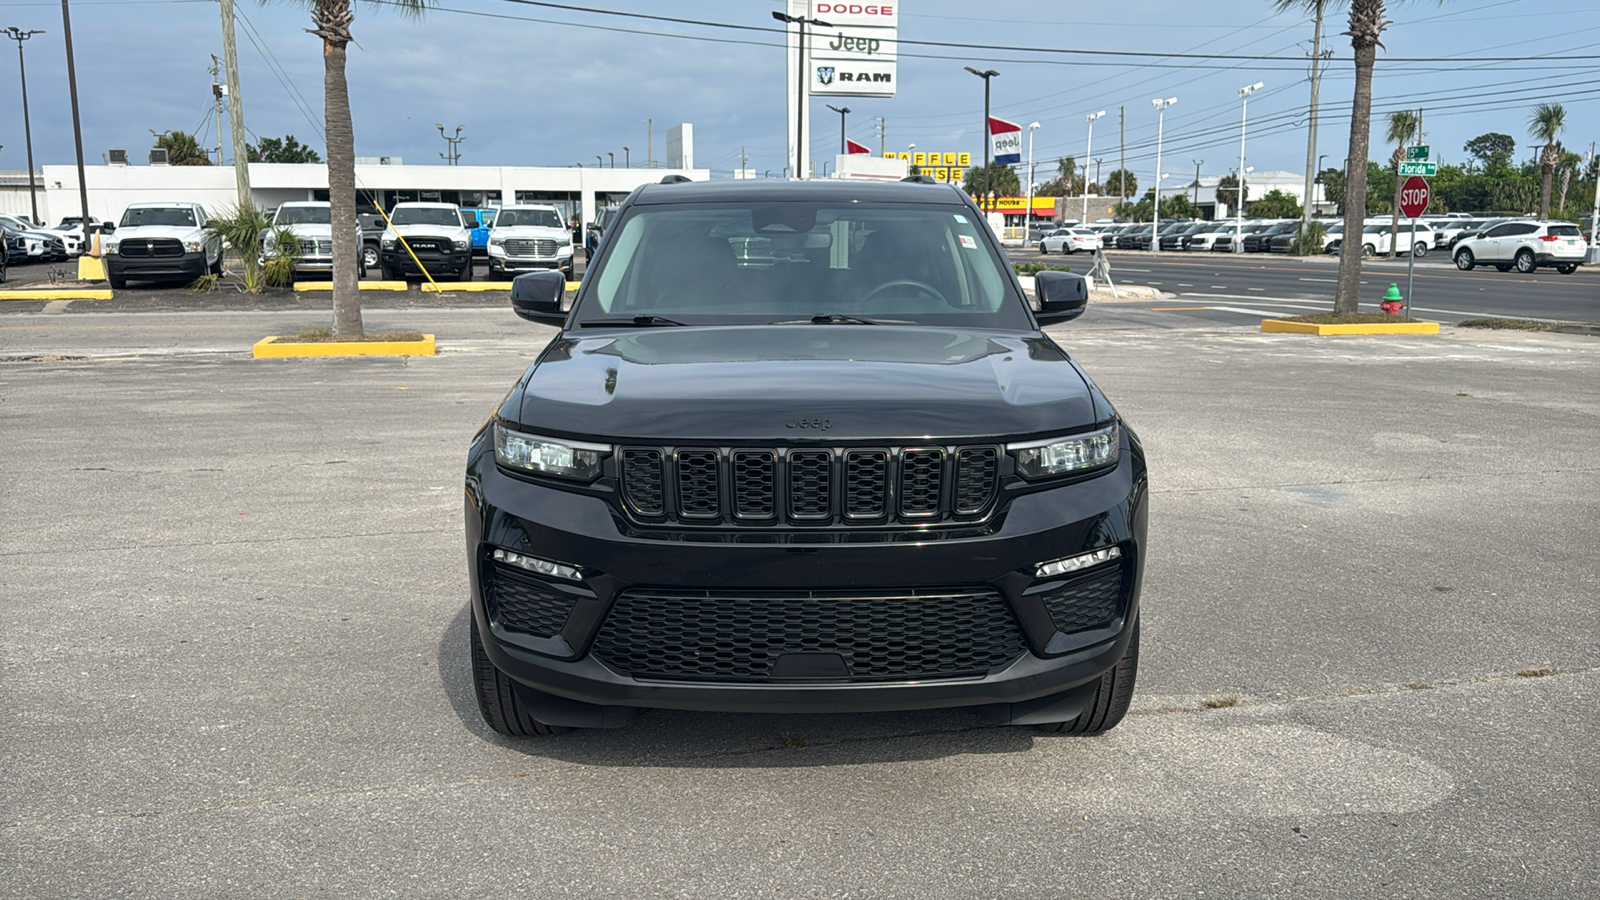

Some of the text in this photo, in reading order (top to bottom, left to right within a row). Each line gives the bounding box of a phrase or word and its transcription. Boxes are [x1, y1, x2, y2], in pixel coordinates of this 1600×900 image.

[817, 4, 893, 16] DODGE
[829, 32, 880, 55] Jeep
[839, 72, 891, 82] RAM
[1400, 163, 1426, 174] Florida
[1402, 188, 1427, 206] STOP
[785, 414, 832, 432] Jeep
